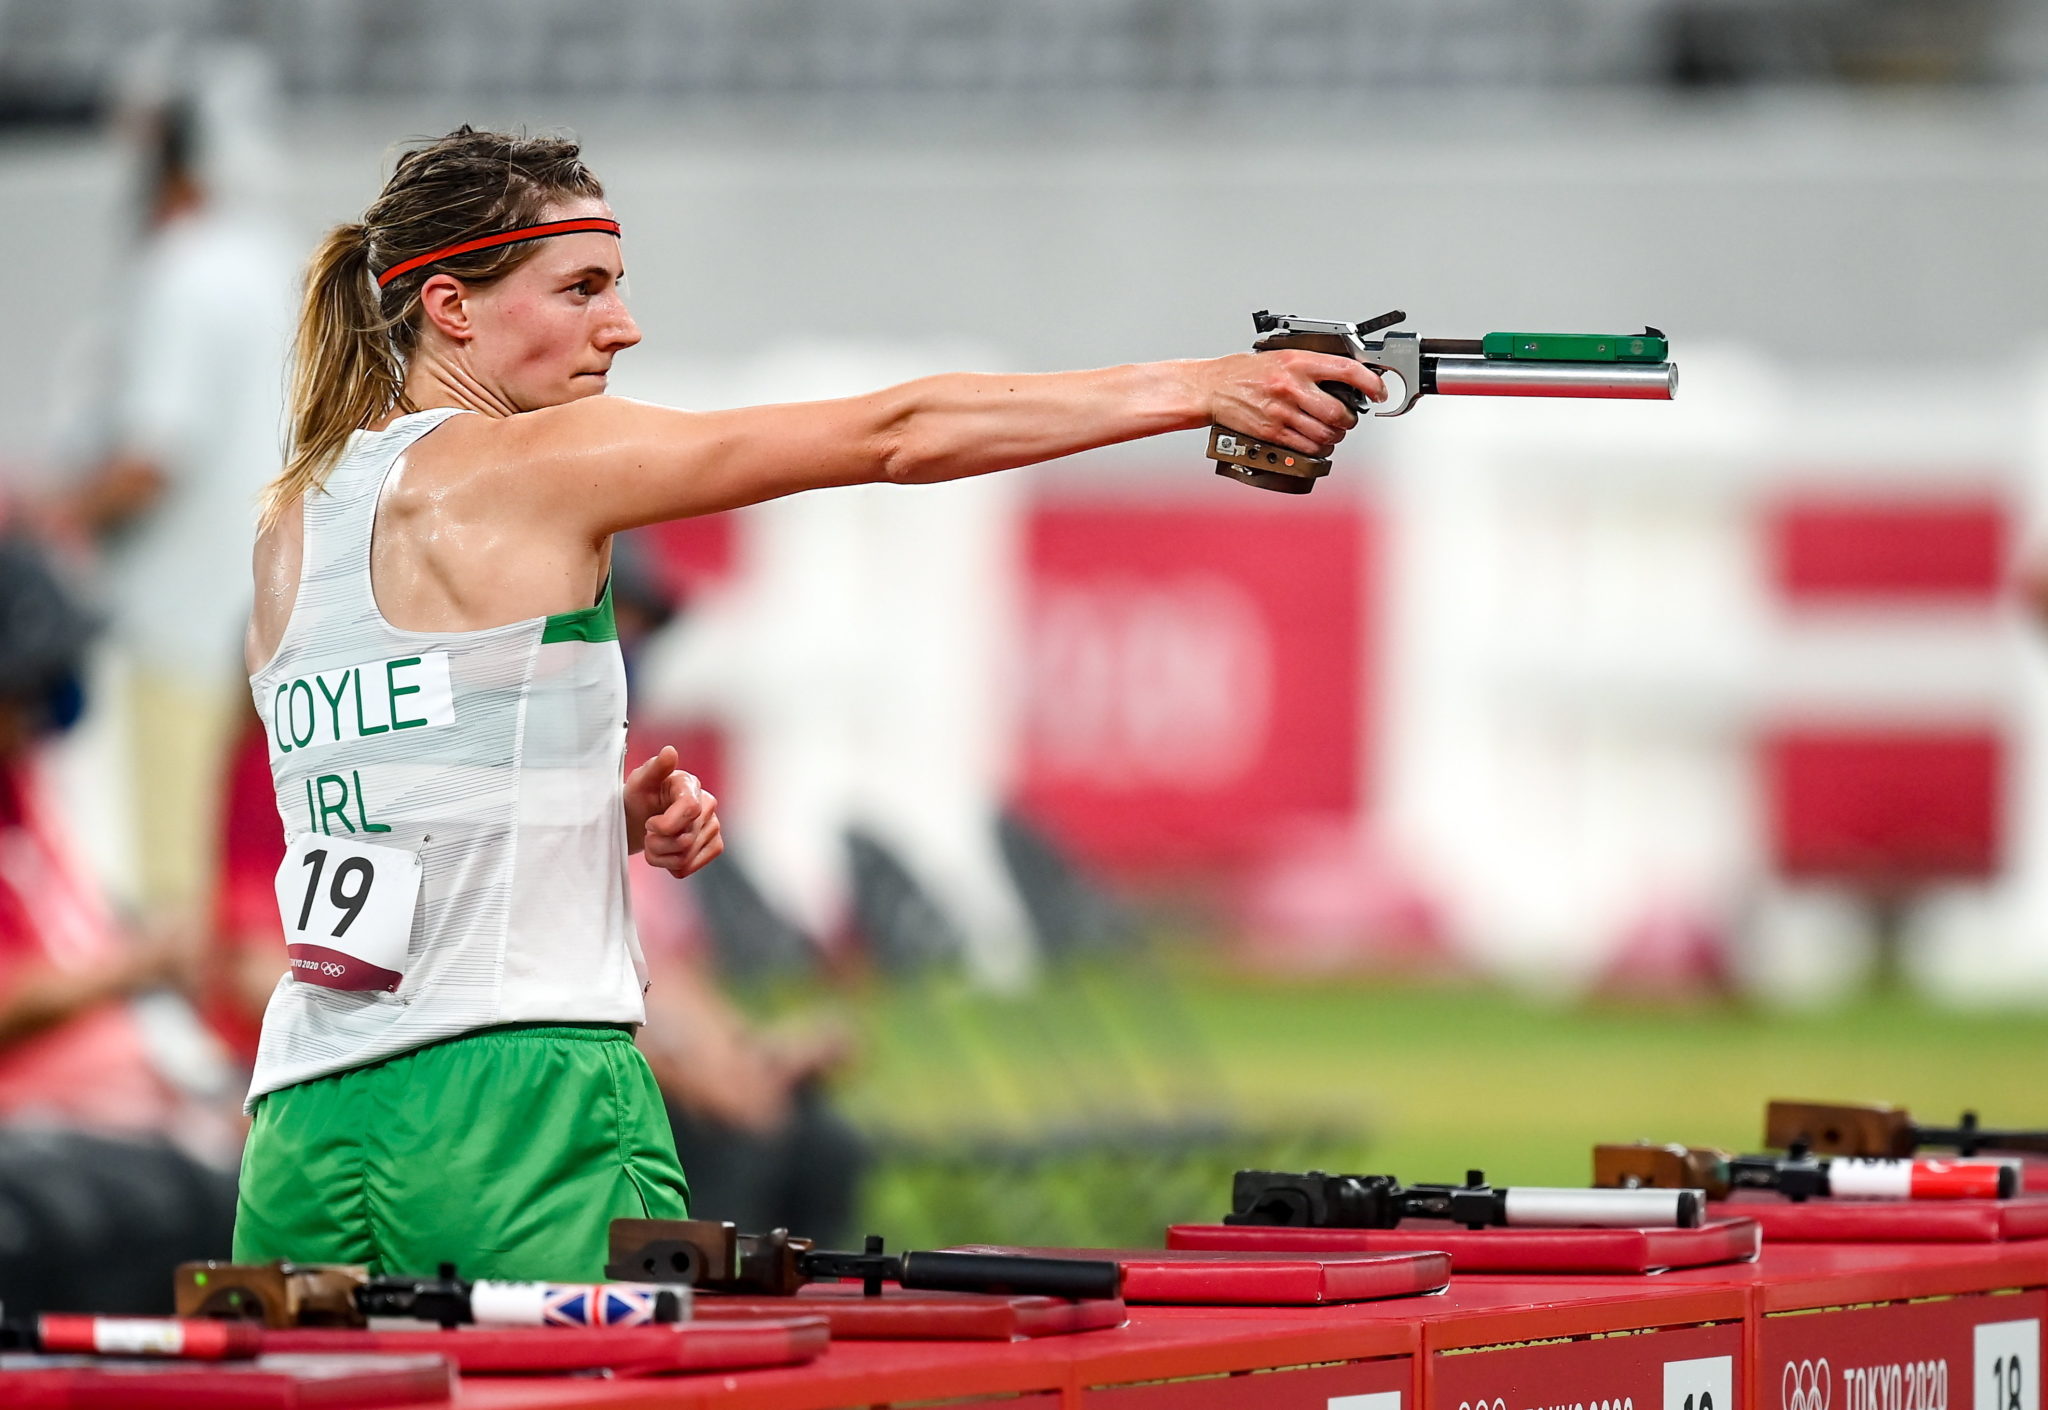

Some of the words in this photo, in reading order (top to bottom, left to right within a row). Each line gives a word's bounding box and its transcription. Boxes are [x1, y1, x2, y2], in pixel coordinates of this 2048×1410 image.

[274, 657, 428, 753] COYLE
[306, 769, 392, 836] IRL
[297, 849, 375, 938] 19
[302, 960, 319, 970] 2020
[1844, 1364, 1903, 1410] TOKYO
[1905, 1358, 1948, 1410] 2020
